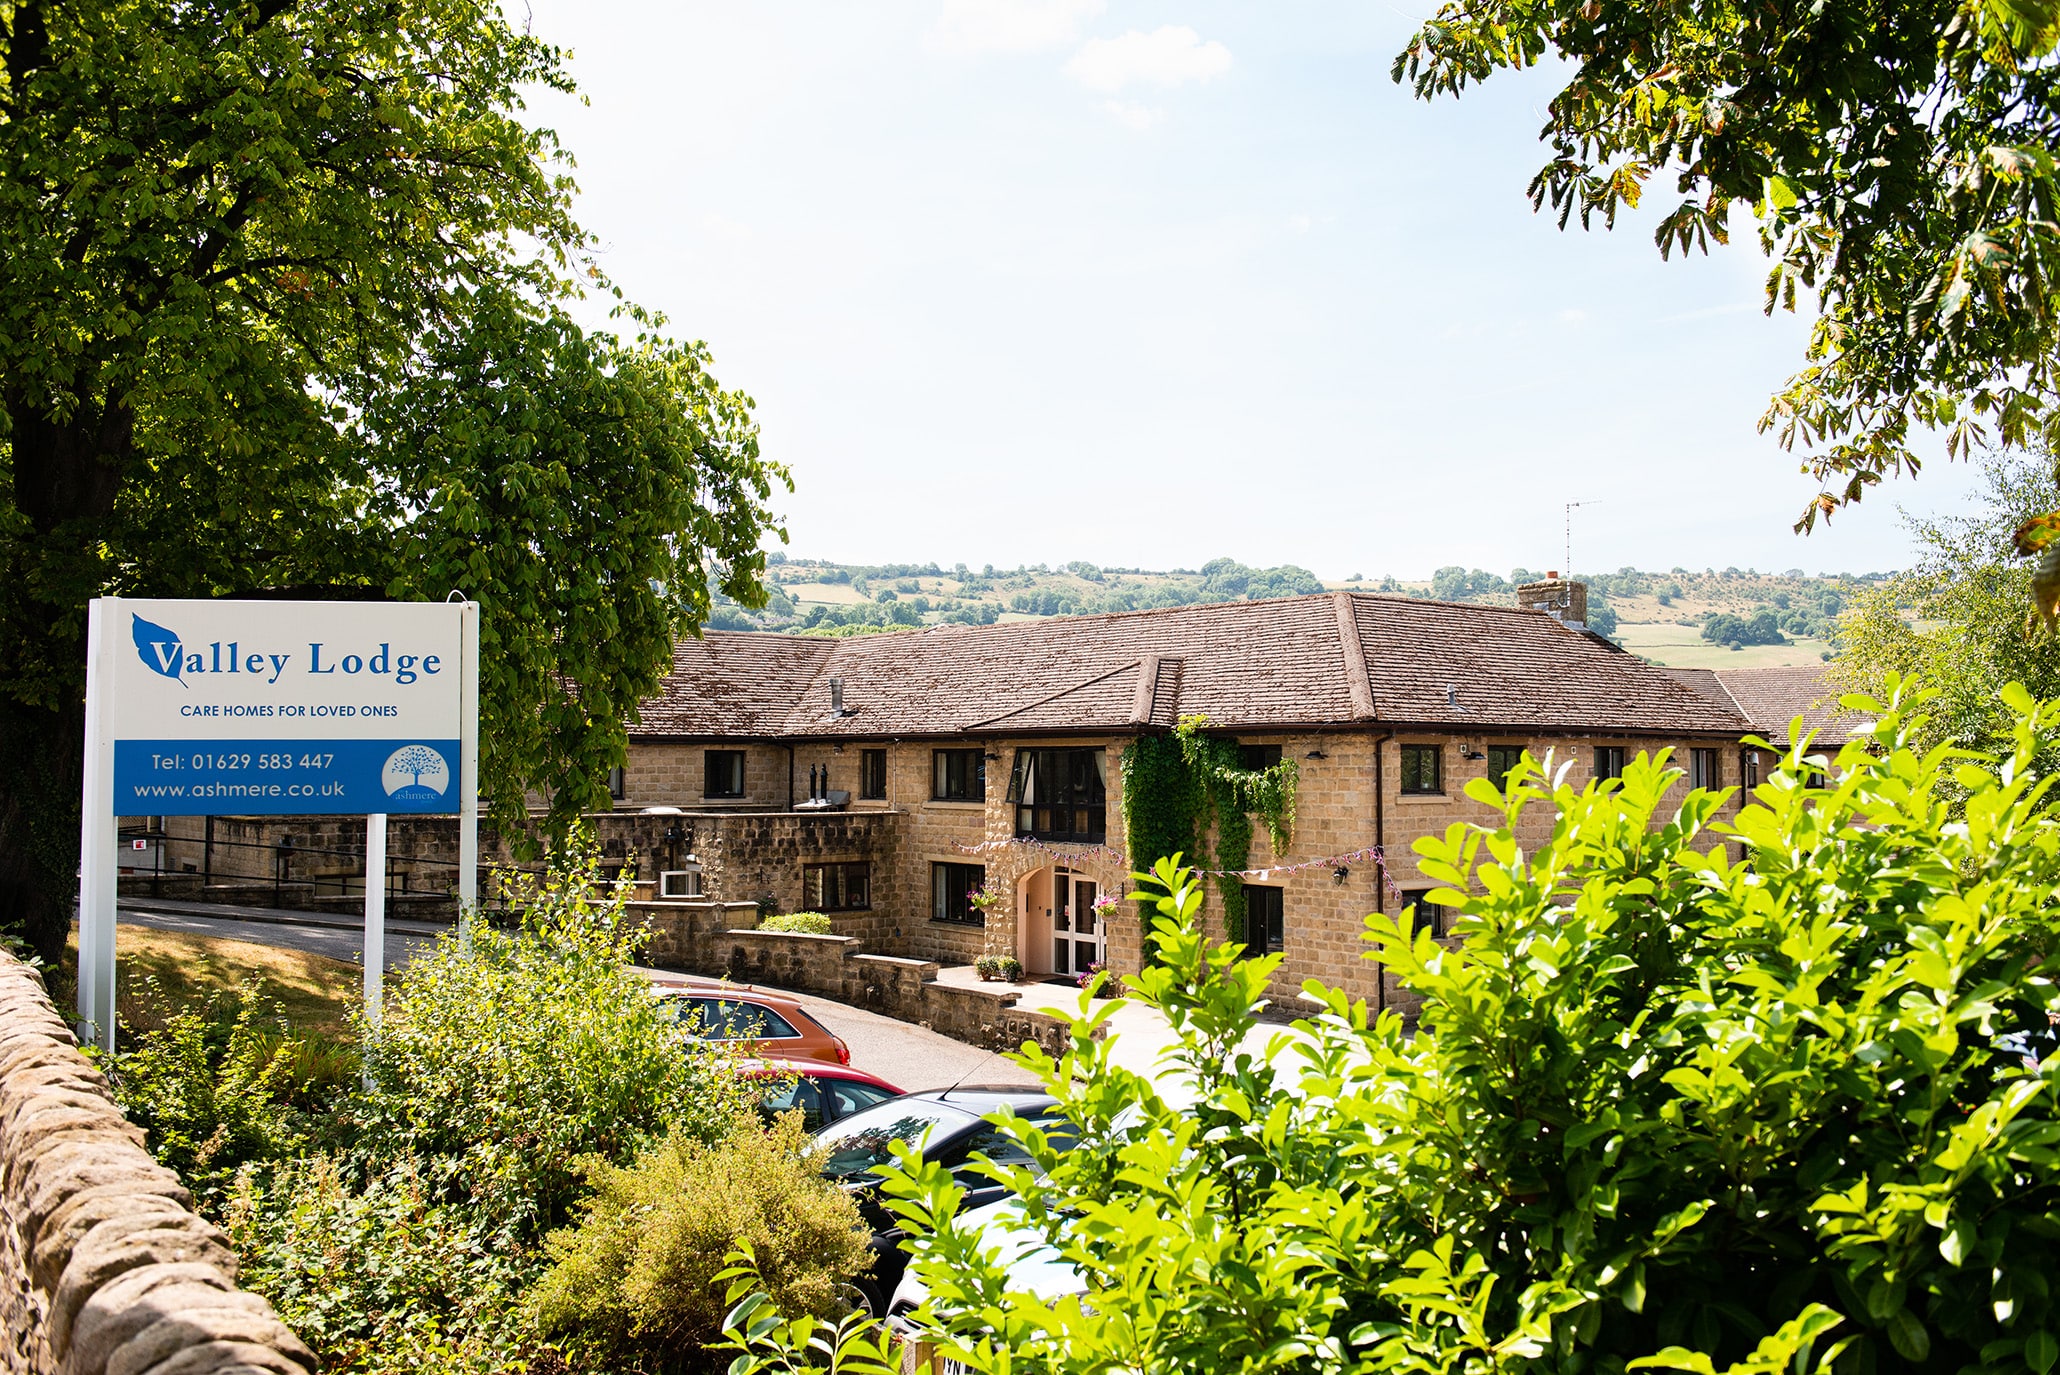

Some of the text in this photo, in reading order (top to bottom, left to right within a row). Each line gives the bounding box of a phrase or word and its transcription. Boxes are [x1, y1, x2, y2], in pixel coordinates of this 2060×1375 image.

[150, 641, 442, 685] Valley Lodge
[180, 705, 398, 717] CARE HOMES FOR LOVED ONES
[152, 754, 334, 770] Tel: 01629 583 447
[133, 780, 345, 797] www.ashmere.co.uk
[395, 789, 437, 800] ashmere
